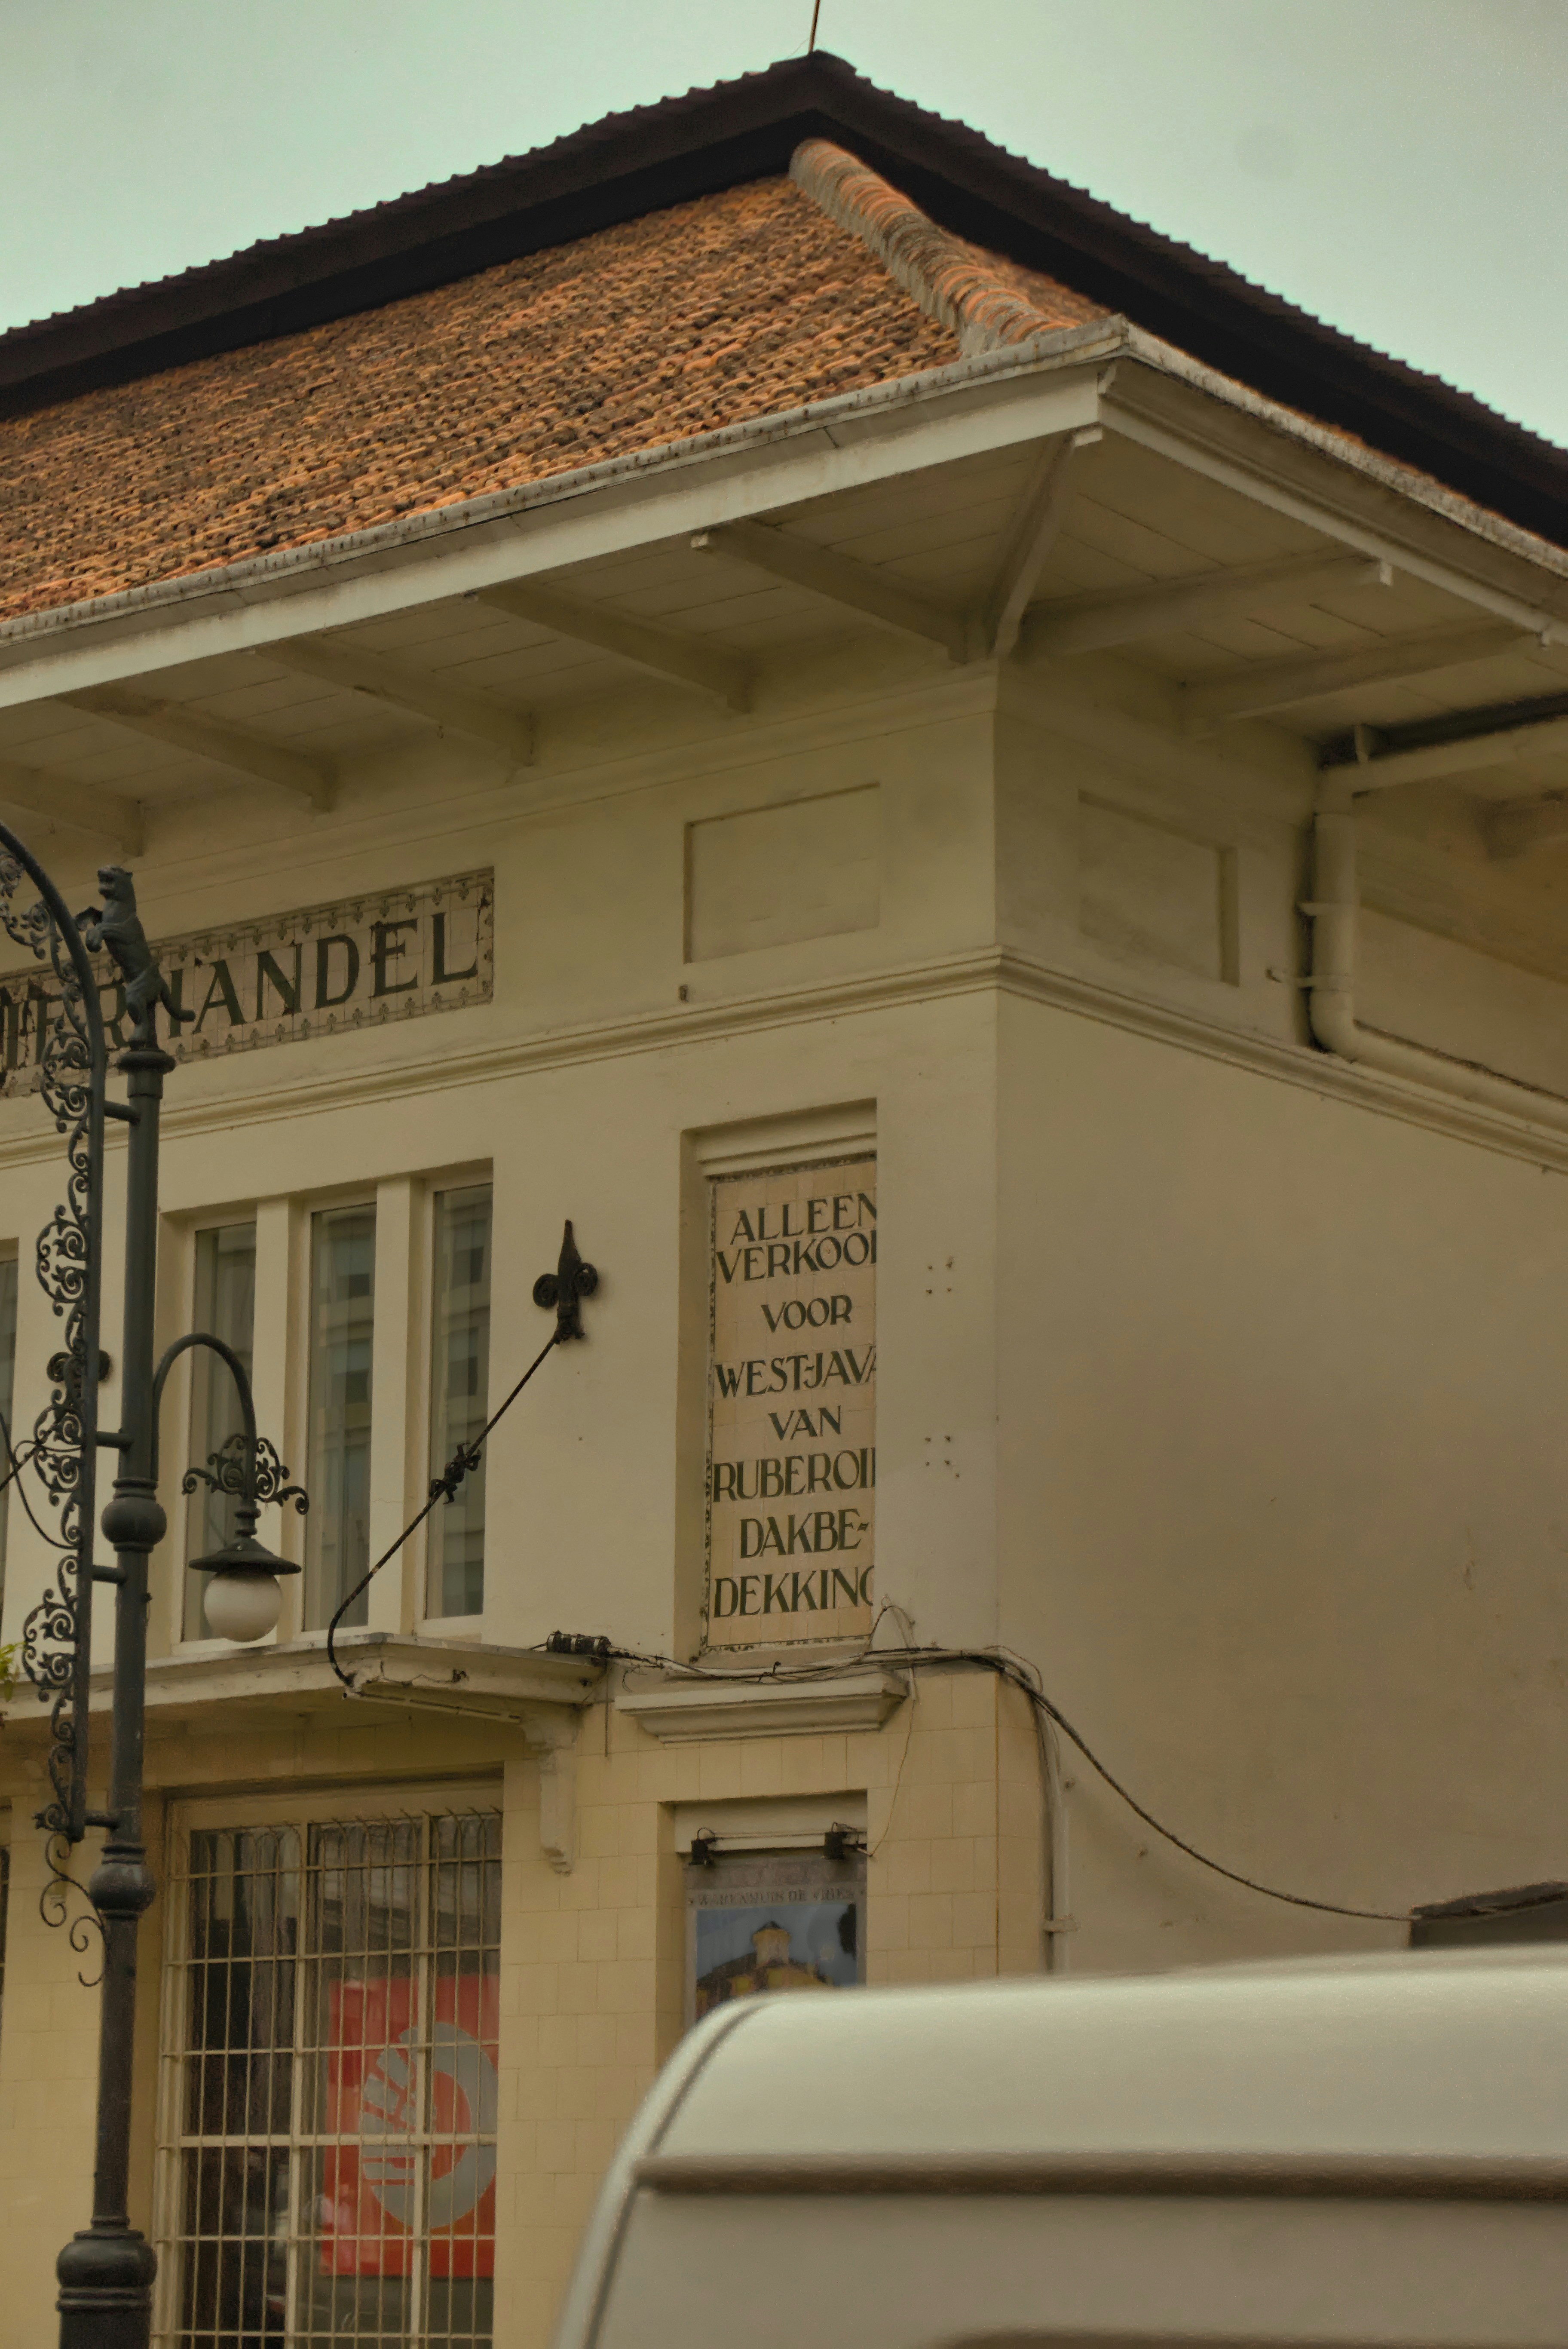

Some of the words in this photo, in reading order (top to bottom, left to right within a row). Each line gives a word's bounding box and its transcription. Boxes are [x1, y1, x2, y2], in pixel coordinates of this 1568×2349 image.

[716, 1230, 876, 1284] VERKOO
[760, 1294, 852, 1333] VOOR
[768, 1405, 842, 1441] VAN
[713, 1447, 876, 1503] RUBEROI
